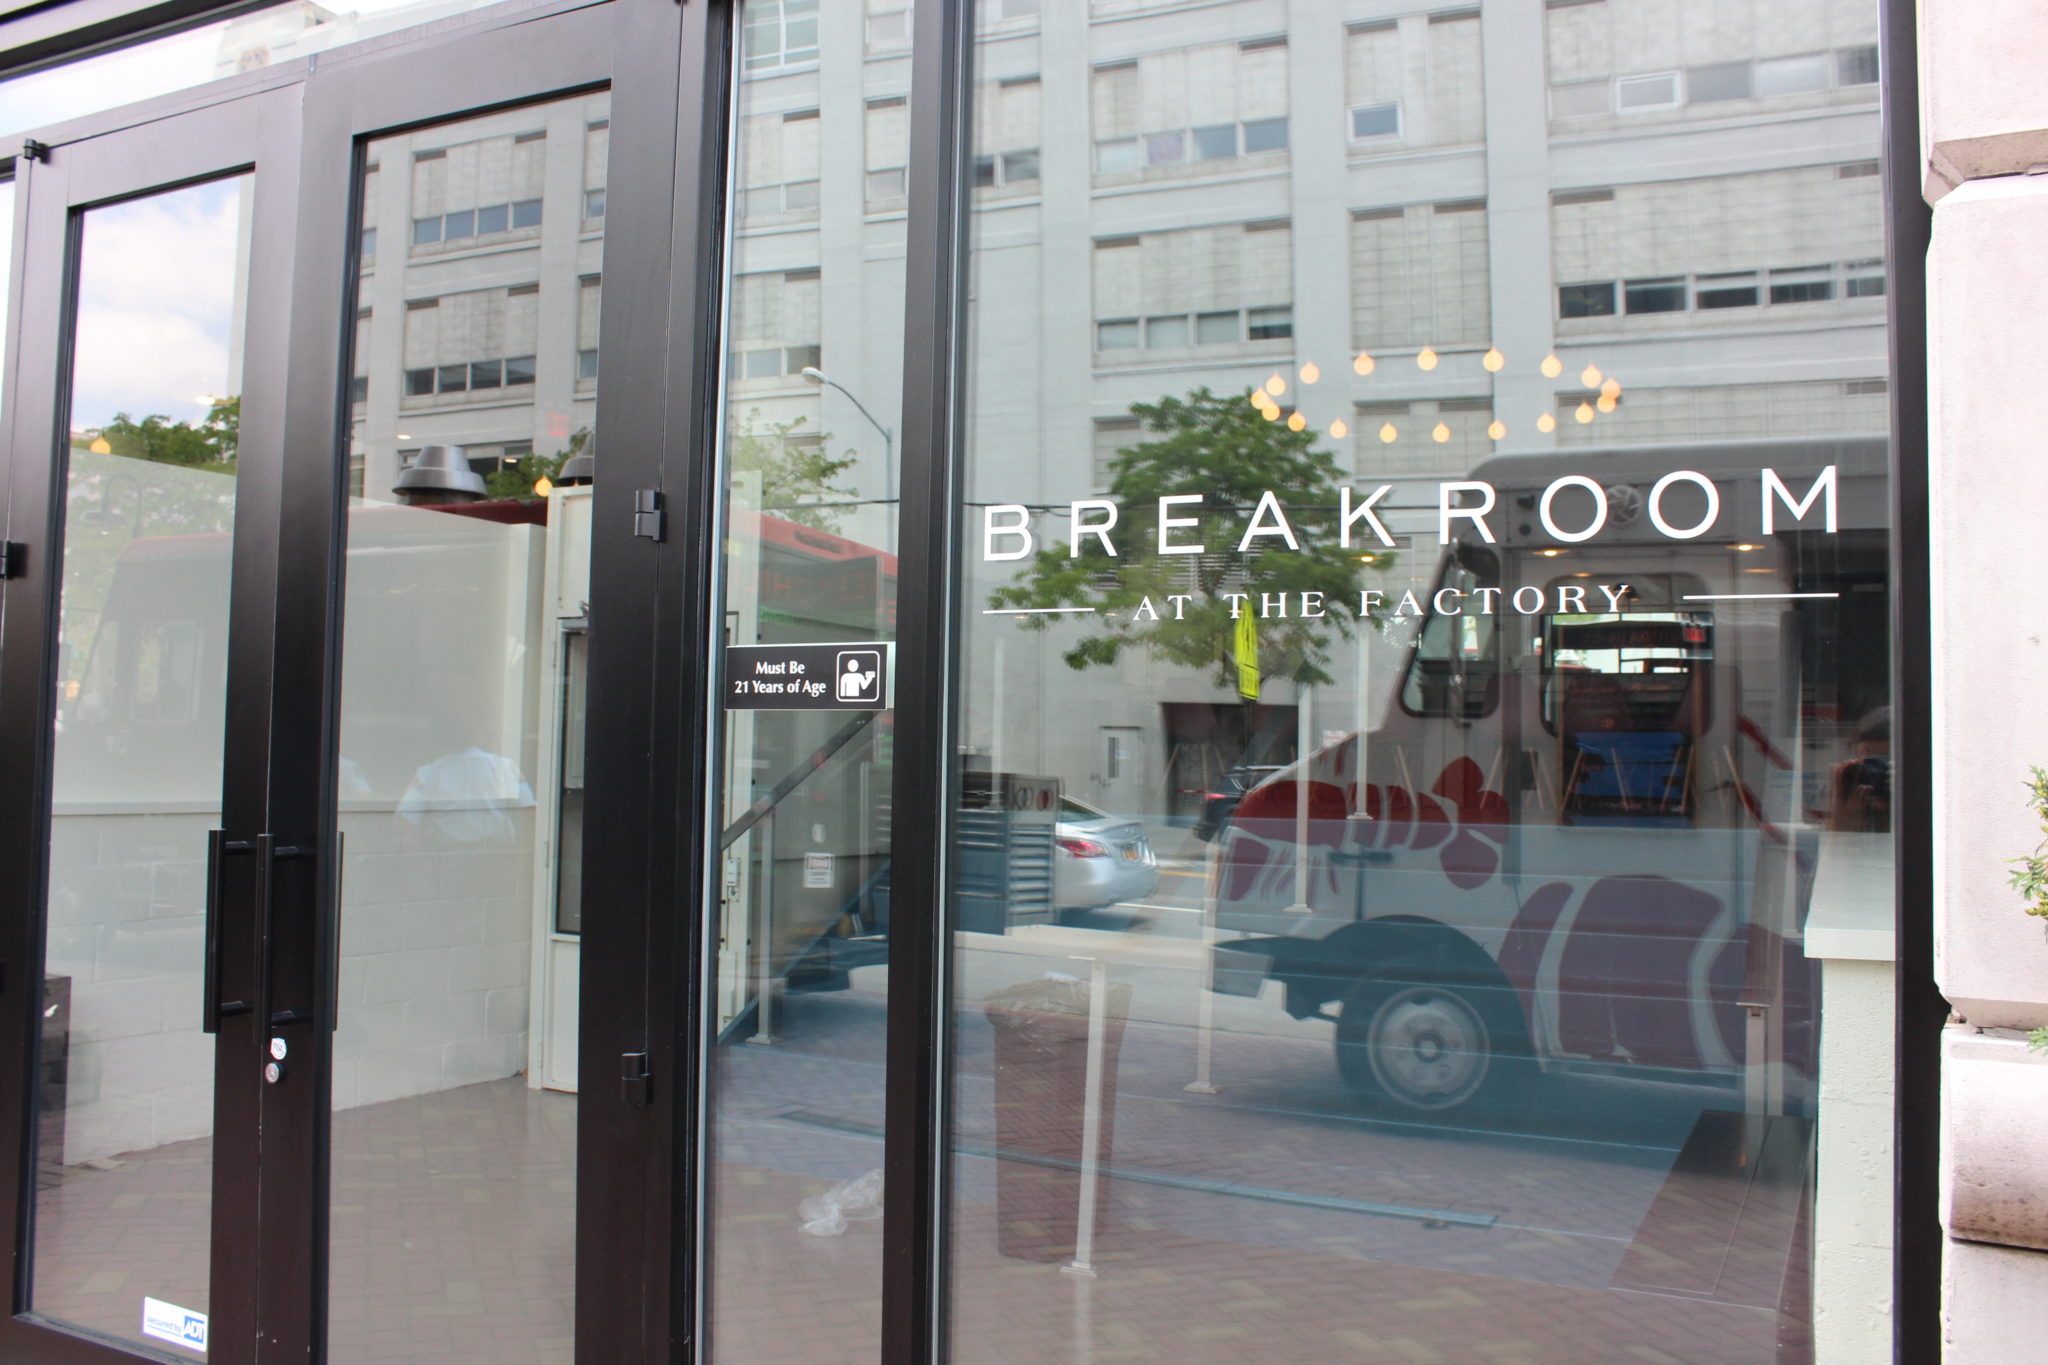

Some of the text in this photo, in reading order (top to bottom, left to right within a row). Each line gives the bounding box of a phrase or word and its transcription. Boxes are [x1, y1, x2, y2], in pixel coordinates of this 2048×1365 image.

[983, 465, 1838, 562] BREAKROOM
[1132, 584, 1633, 621] AT THE FACTORY
[755, 660, 806, 675] Must Be
[734, 679, 827, 698] 21 Years of Age
[184, 1316, 205, 1342] ADT
